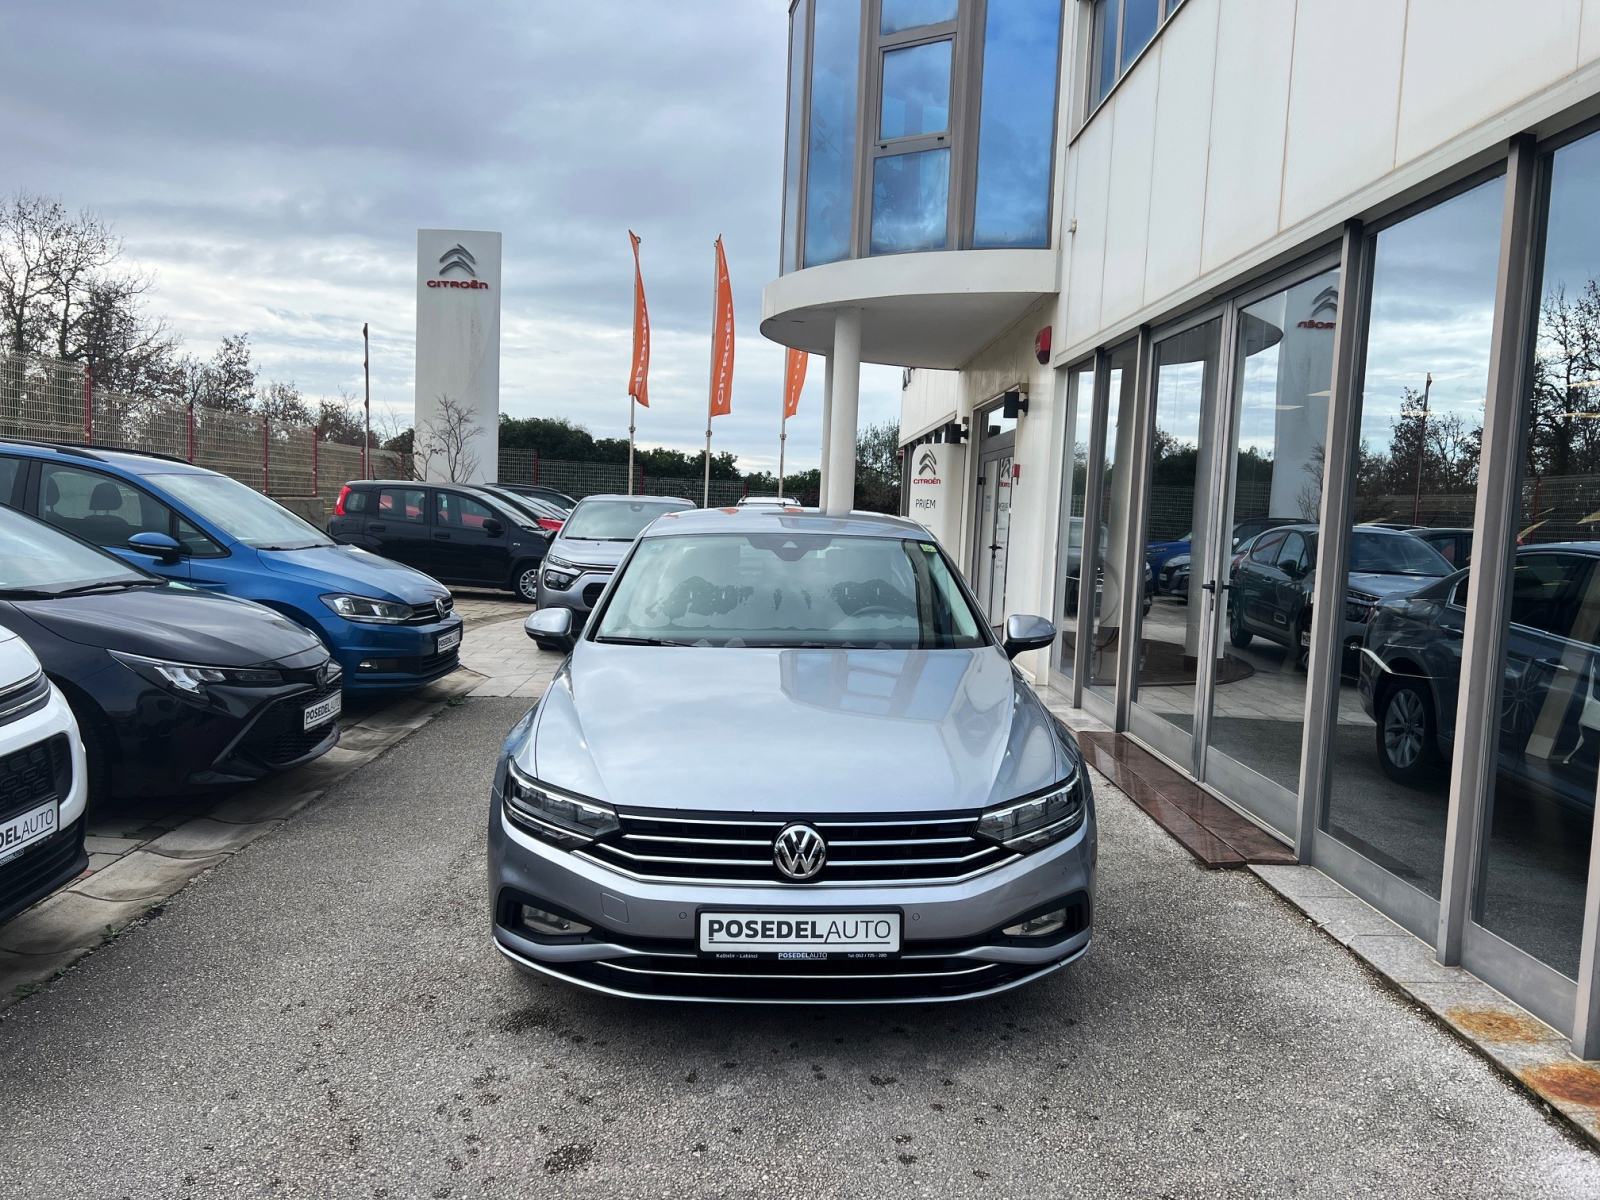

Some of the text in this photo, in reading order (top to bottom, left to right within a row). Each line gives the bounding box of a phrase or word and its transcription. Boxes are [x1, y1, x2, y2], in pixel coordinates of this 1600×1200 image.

[427, 279, 489, 290] CITROËN
[913, 477, 941, 485] CITROËN
[915, 498, 936, 510] PRIJEM
